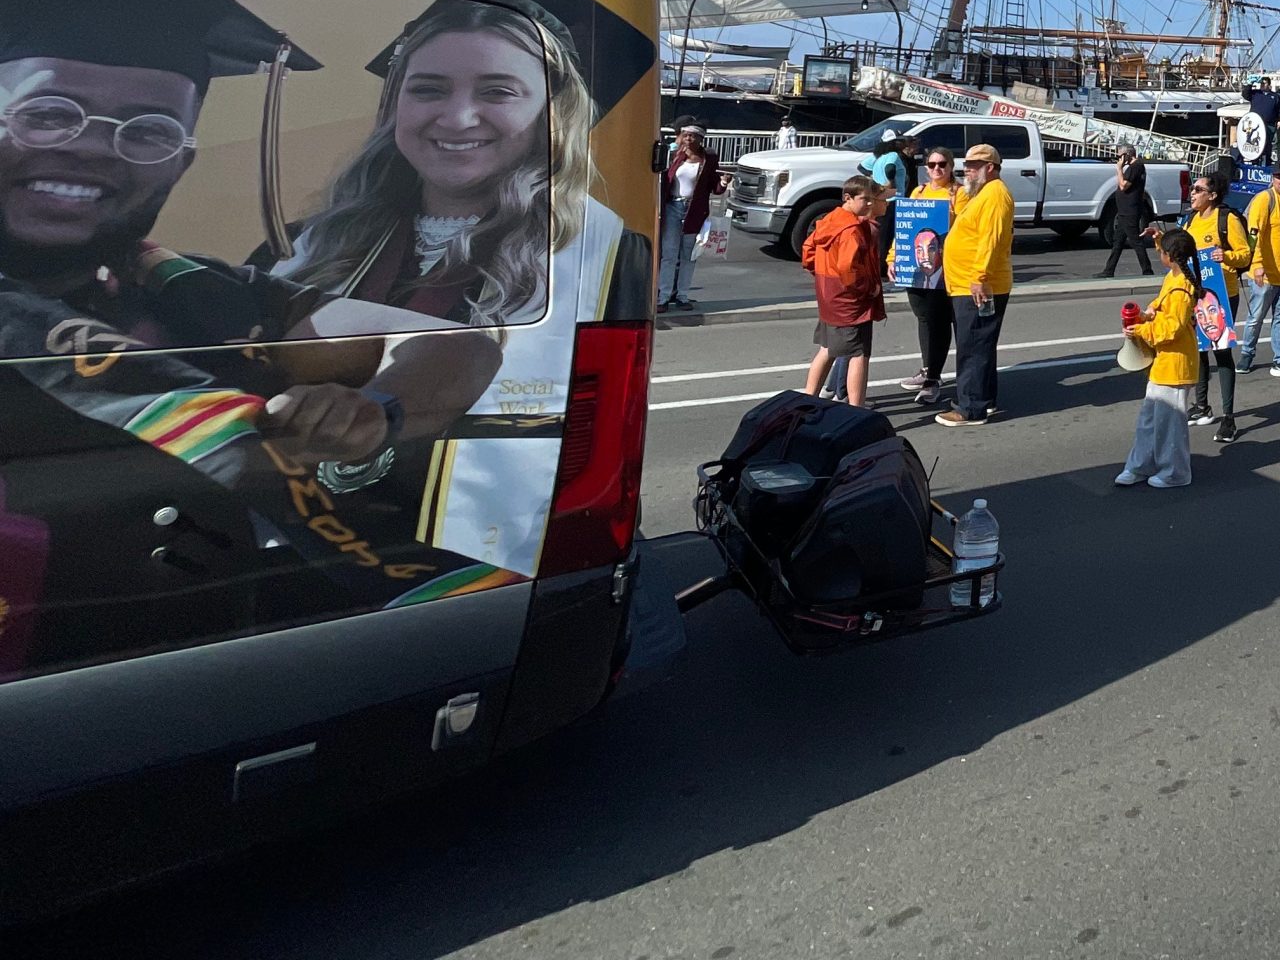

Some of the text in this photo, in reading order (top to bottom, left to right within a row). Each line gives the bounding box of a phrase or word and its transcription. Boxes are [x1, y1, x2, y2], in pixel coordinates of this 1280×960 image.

[908, 83, 931, 95] SAIL
[943, 93, 979, 107] STEAM
[1000, 104, 1024, 117] ONE
[913, 200, 935, 208] decided
[1200, 266, 1214, 280] ght
[498, 378, 555, 396] Social
